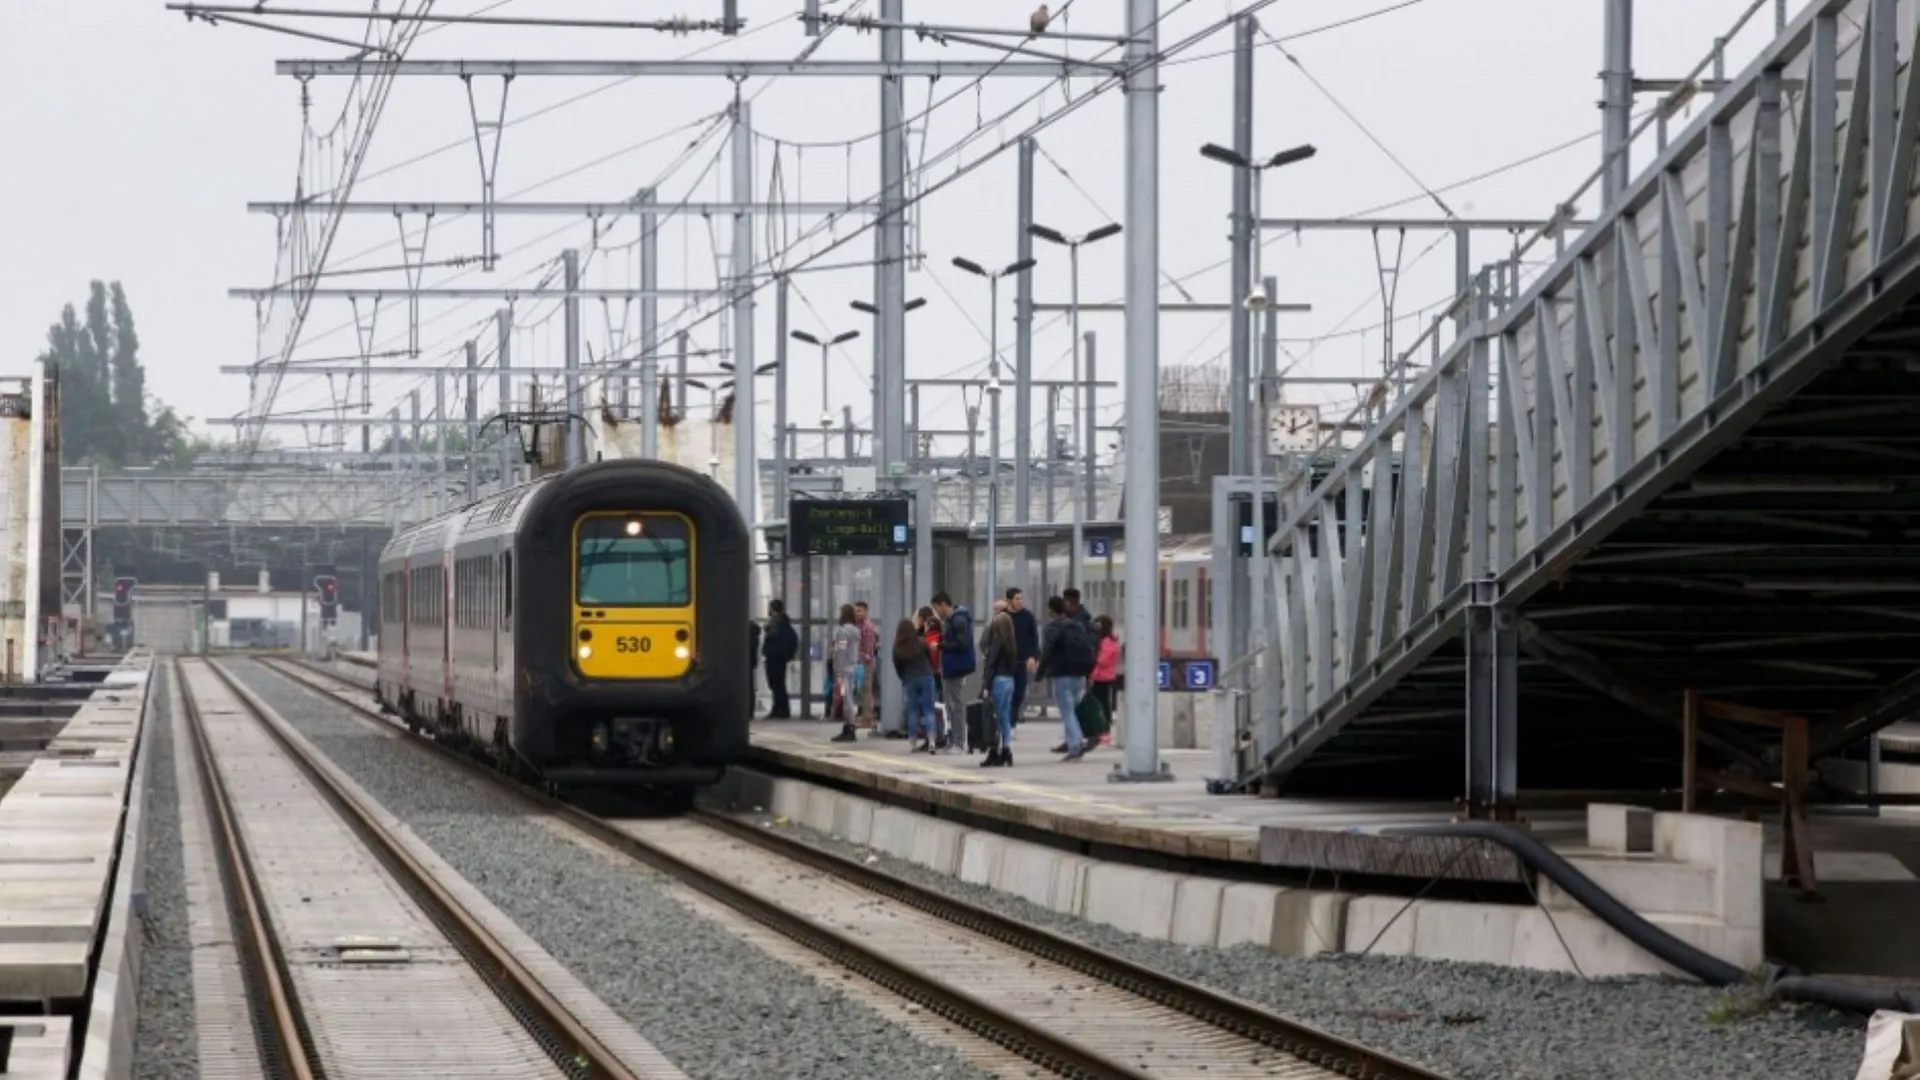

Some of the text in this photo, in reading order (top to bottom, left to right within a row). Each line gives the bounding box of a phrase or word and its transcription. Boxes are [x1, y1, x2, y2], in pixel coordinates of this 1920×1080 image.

[1095, 542, 1105, 554] 3
[616, 636, 652, 654] 530
[1194, 670, 1206, 685] 3
